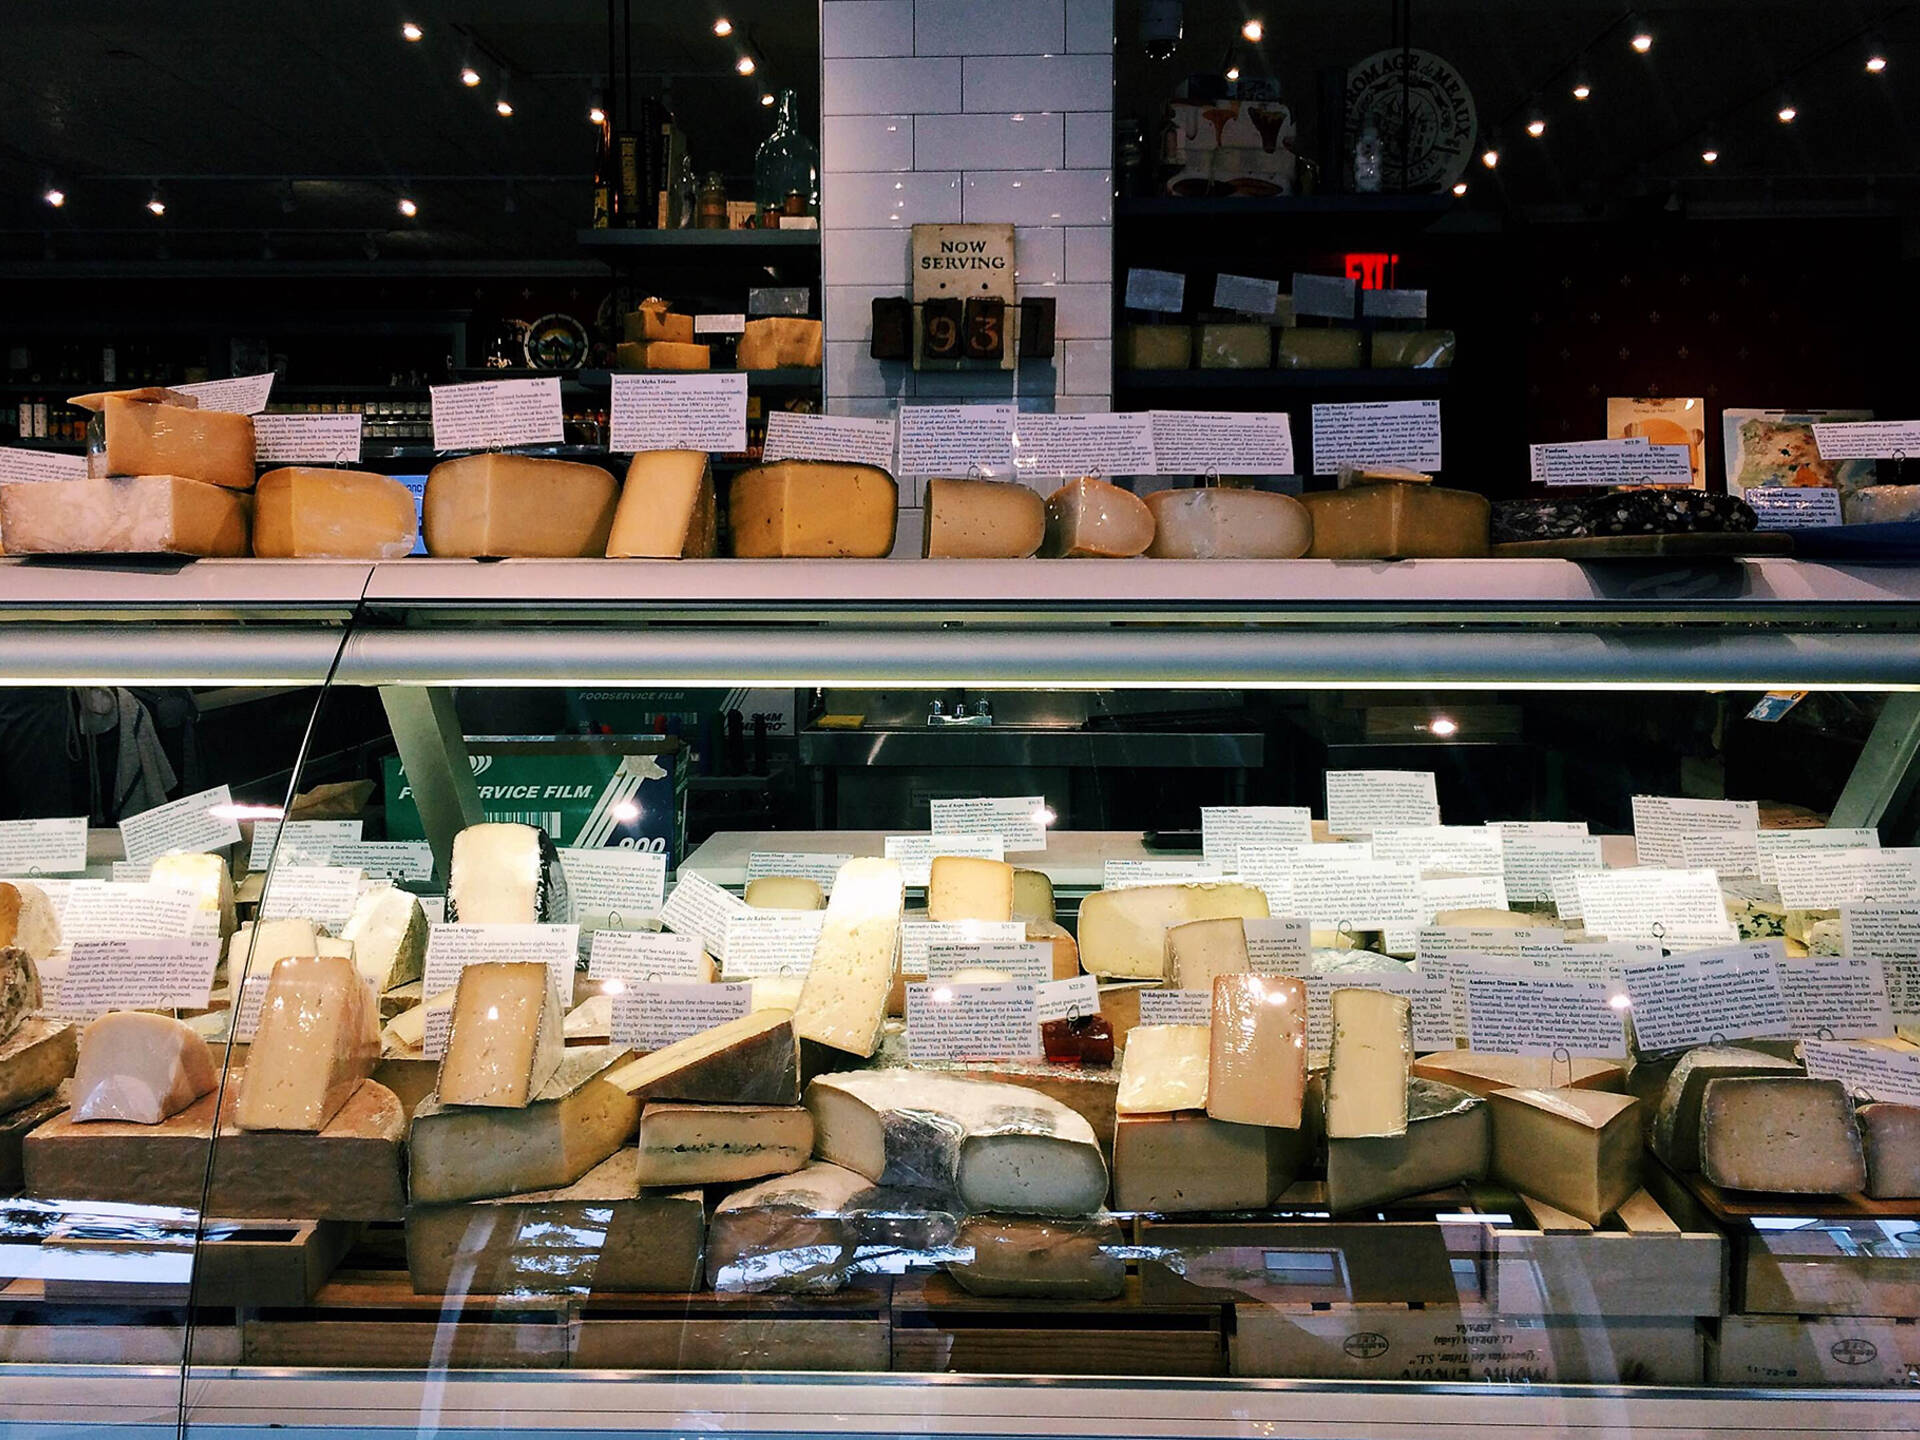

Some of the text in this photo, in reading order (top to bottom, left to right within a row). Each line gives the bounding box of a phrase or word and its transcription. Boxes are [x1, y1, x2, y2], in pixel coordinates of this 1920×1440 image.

[1433, 64, 1470, 140] MEAUX
[941, 241, 986, 253] NOW
[921, 257, 1006, 270] SERVING
[578, 692, 685, 700] FOODSERVICE FILM
[543, 785, 592, 798] FILM
